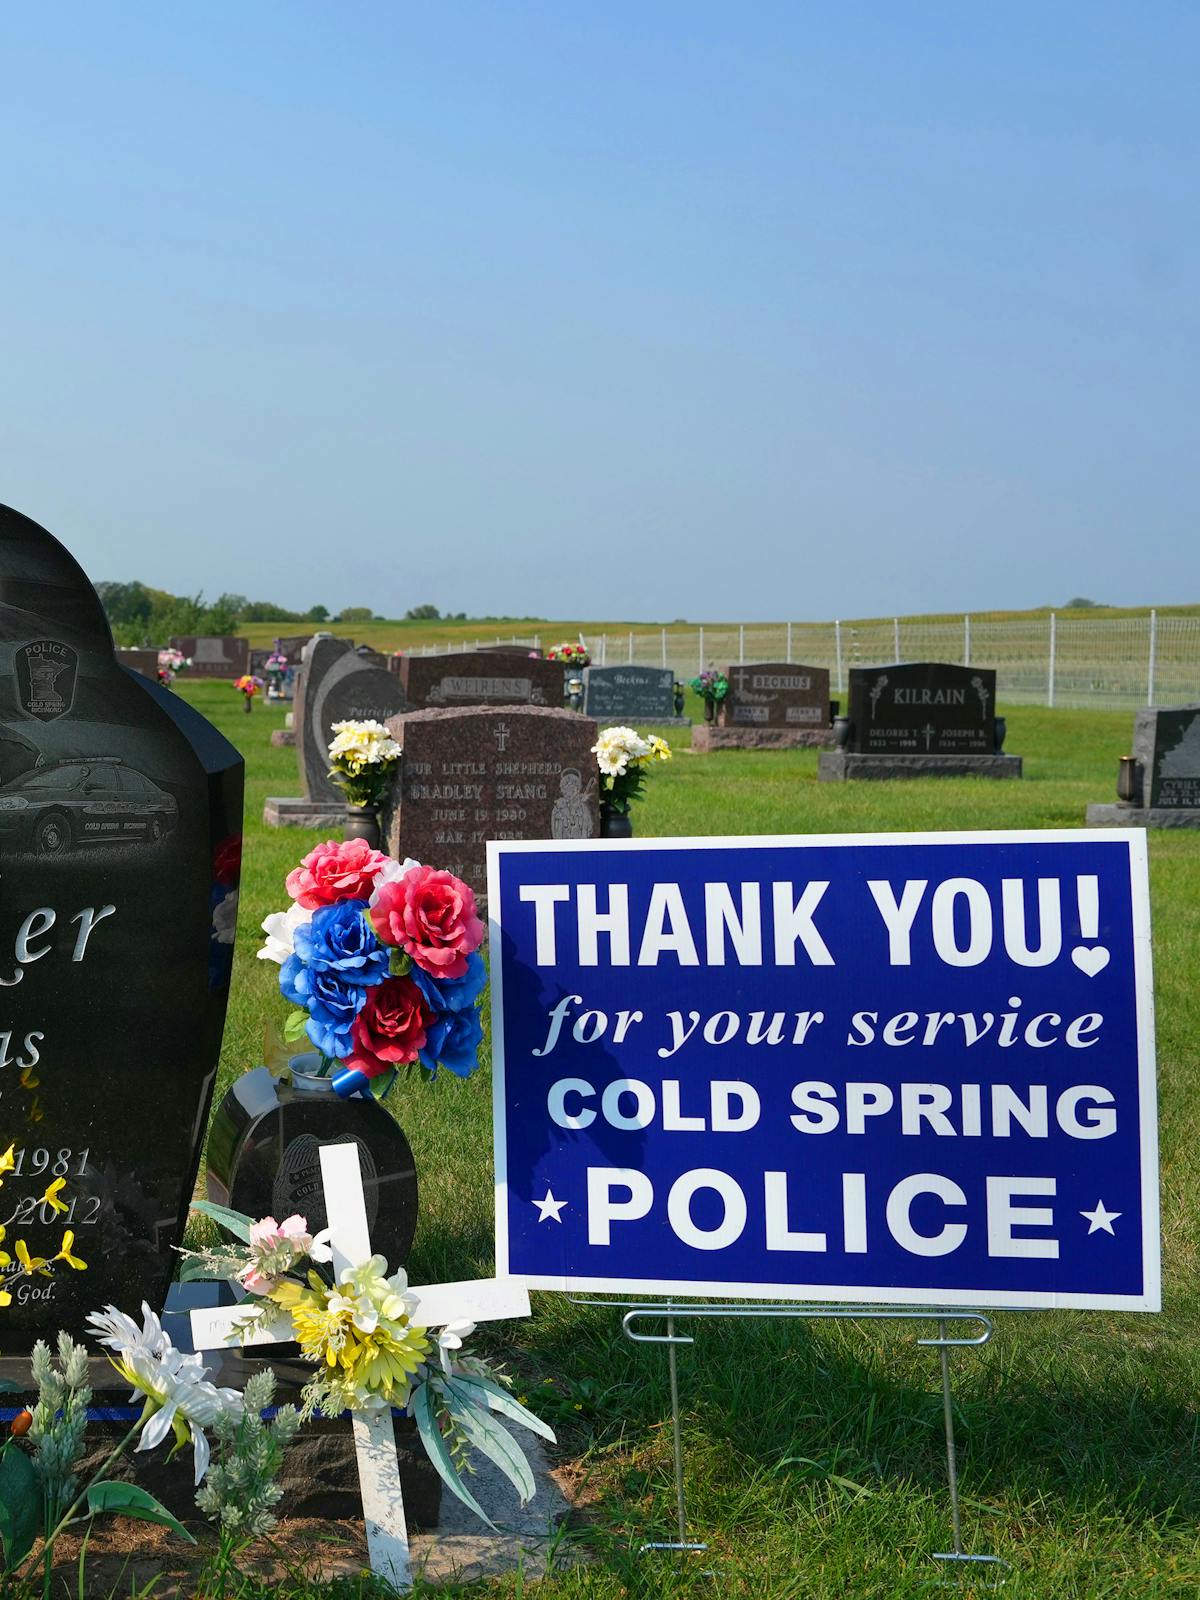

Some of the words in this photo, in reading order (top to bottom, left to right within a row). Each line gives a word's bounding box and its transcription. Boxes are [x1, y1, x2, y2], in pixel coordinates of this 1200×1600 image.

[25, 643, 68, 657] POLICE
[451, 679, 523, 693] WEIRENS
[756, 677, 808, 687] BECKIUS
[894, 688, 966, 704] KILRAIN
[443, 762, 486, 775] LITTLE
[495, 762, 562, 775] SHEPHERD
[410, 784, 484, 800] BRADLEY
[496, 784, 548, 799] STANG
[431, 808, 466, 821] JUNE
[519, 880, 835, 966] THANK
[867, 874, 1111, 978] YOU!
[532, 995, 643, 1057] for
[658, 1010, 824, 1058] your
[846, 996, 1103, 1049] service
[547, 1077, 761, 1132] COLD
[789, 1080, 1118, 1140] SPRING
[8, 1147, 94, 1177] 1981
[297, 1182, 319, 1197] COLD
[17, 1195, 101, 1225] 2012
[586, 1165, 1060, 1259] POLICE
[17, 1281, 56, 1305] God.
